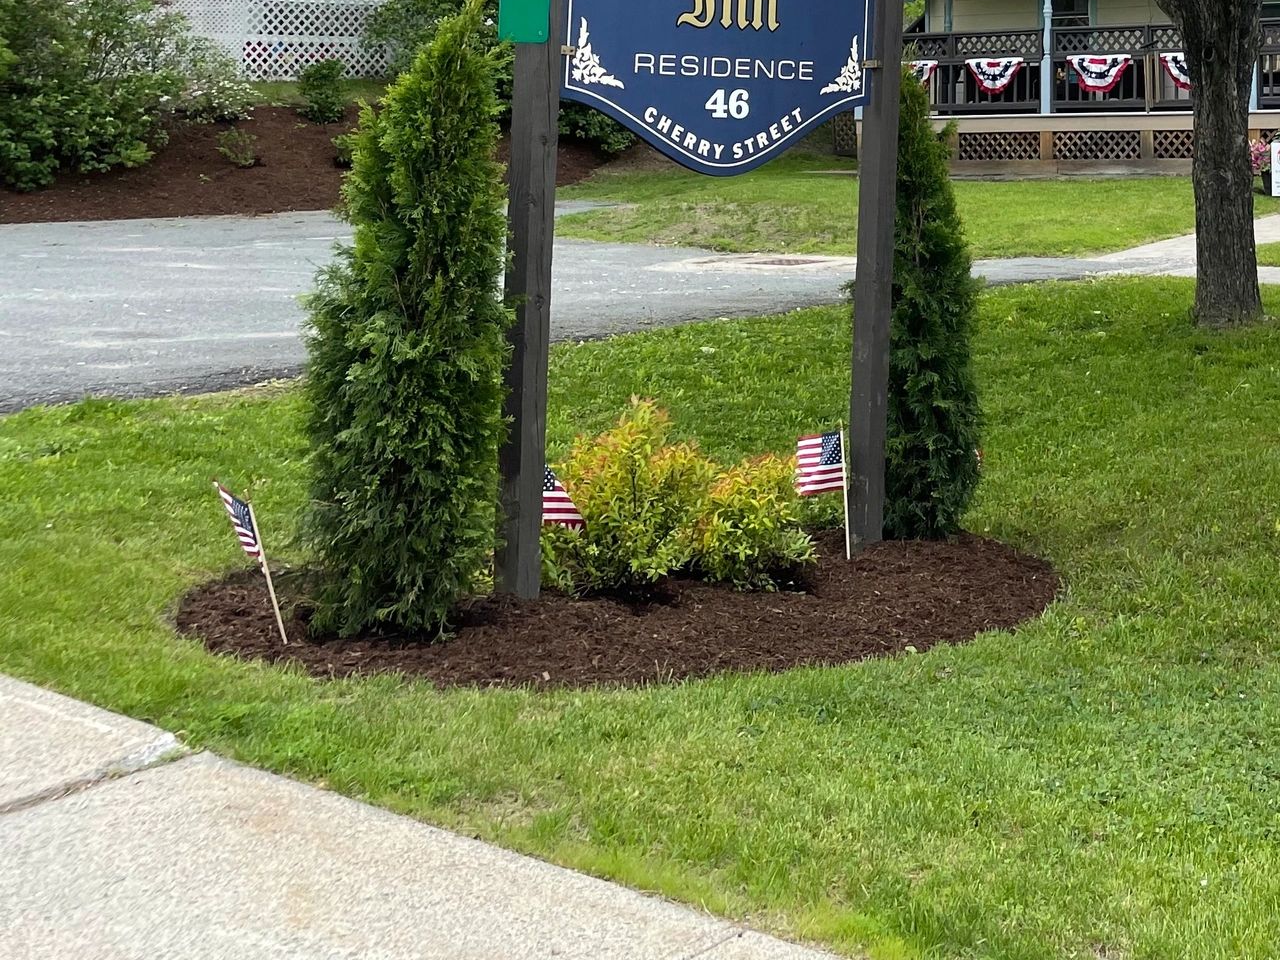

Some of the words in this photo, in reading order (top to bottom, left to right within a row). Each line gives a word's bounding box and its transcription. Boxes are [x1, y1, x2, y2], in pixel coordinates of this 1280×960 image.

[633, 53, 815, 81] RESIDENCE
[704, 88, 751, 120] 46
[644, 106, 724, 160] CHERRY
[732, 106, 804, 159] STREET
